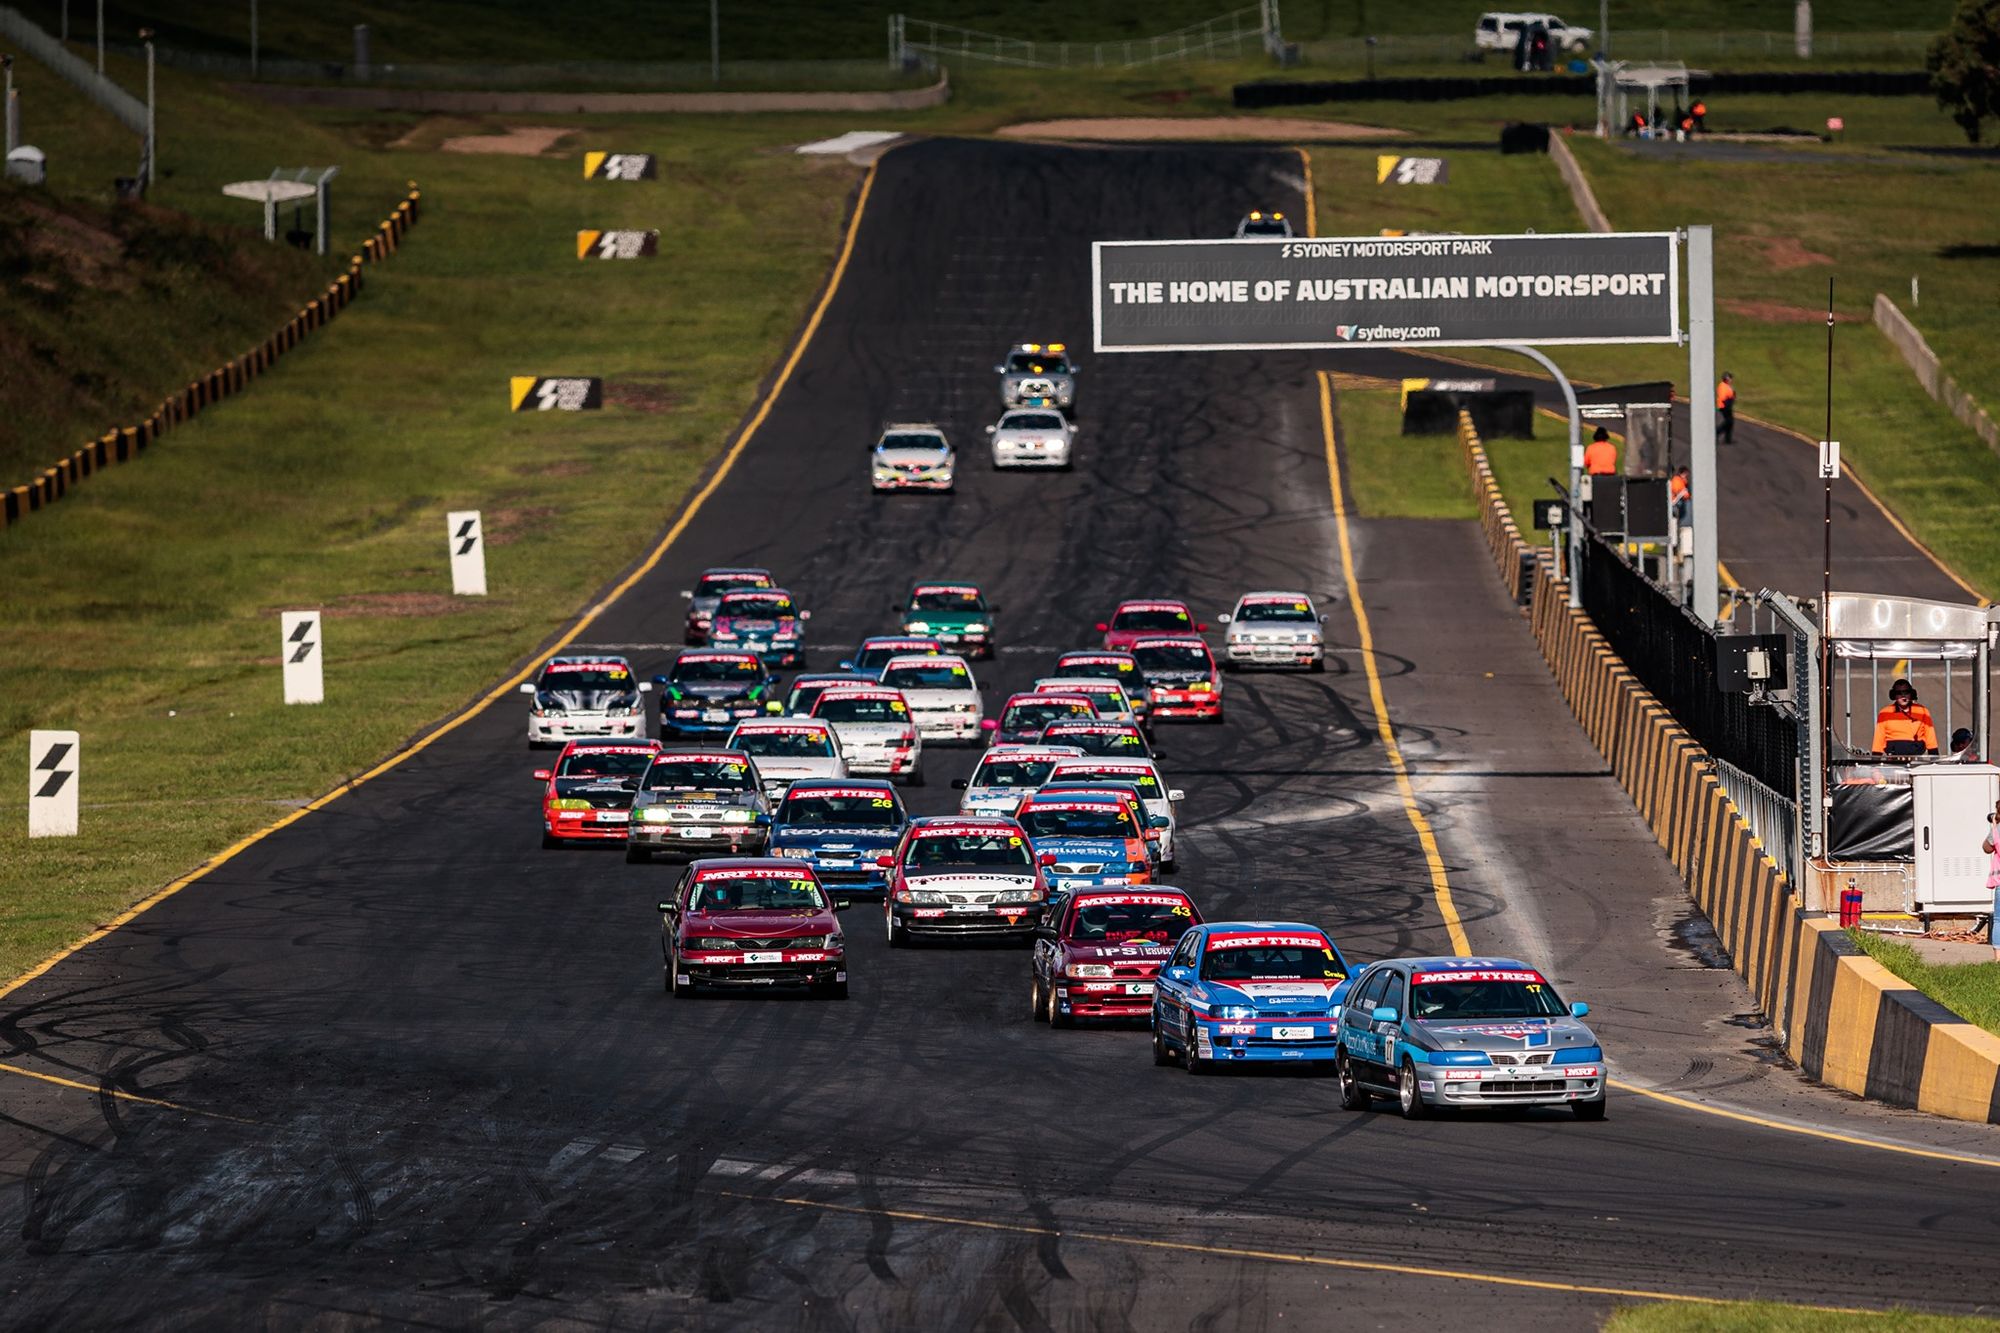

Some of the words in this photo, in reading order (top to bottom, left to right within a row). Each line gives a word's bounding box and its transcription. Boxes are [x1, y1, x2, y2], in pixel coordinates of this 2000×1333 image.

[1293, 242, 1351, 259] SYDNEY
[1353, 241, 1451, 257] MOTORSPORT
[1453, 240, 1492, 255] PARK
[1109, 281, 1163, 304] THE
[1170, 280, 1249, 303] HOME
[1255, 279, 1291, 302] OF
[1296, 276, 1470, 301] AUSTRALIAN
[1476, 273, 1665, 299] MOTORSPORT
[1357, 324, 1441, 342] sydney.com
[1121, 736, 1140, 745] 274
[1139, 776, 1155, 786] 66
[795, 790, 839, 799] MRF
[840, 790, 886, 799] TYRES
[872, 798, 893, 808] 26
[1028, 804, 1074, 813] MRF
[1075, 803, 1121, 812] TYRES
[1117, 812, 1130, 822] 4
[780, 828, 899, 838] Reynolds
[919, 829, 965, 838] MRF
[967, 828, 1014, 837] TYRES
[1009, 837, 1023, 847] 6
[703, 870, 752, 881] MRF
[753, 870, 805, 879] TYRES
[910, 875, 976, 886] PAYNTER
[978, 875, 1033, 885] DIXON
[789, 880, 815, 891] 777
[1078, 897, 1129, 908] MRF
[1130, 896, 1183, 906] TYRES
[1171, 906, 1192, 917] 43
[1211, 938, 1266, 950] MRF
[1267, 937, 1322, 947] TYRES
[1096, 947, 1138, 957] IPS
[1322, 949, 1334, 960] 1
[1324, 970, 1346, 980] Craig
[1421, 972, 1478, 983] MRF
[1479, 971, 1536, 982] TYRES
[1525, 984, 1541, 993] 17
[1446, 1071, 1481, 1079] MRF
[1565, 1067, 1596, 1077] MRF
